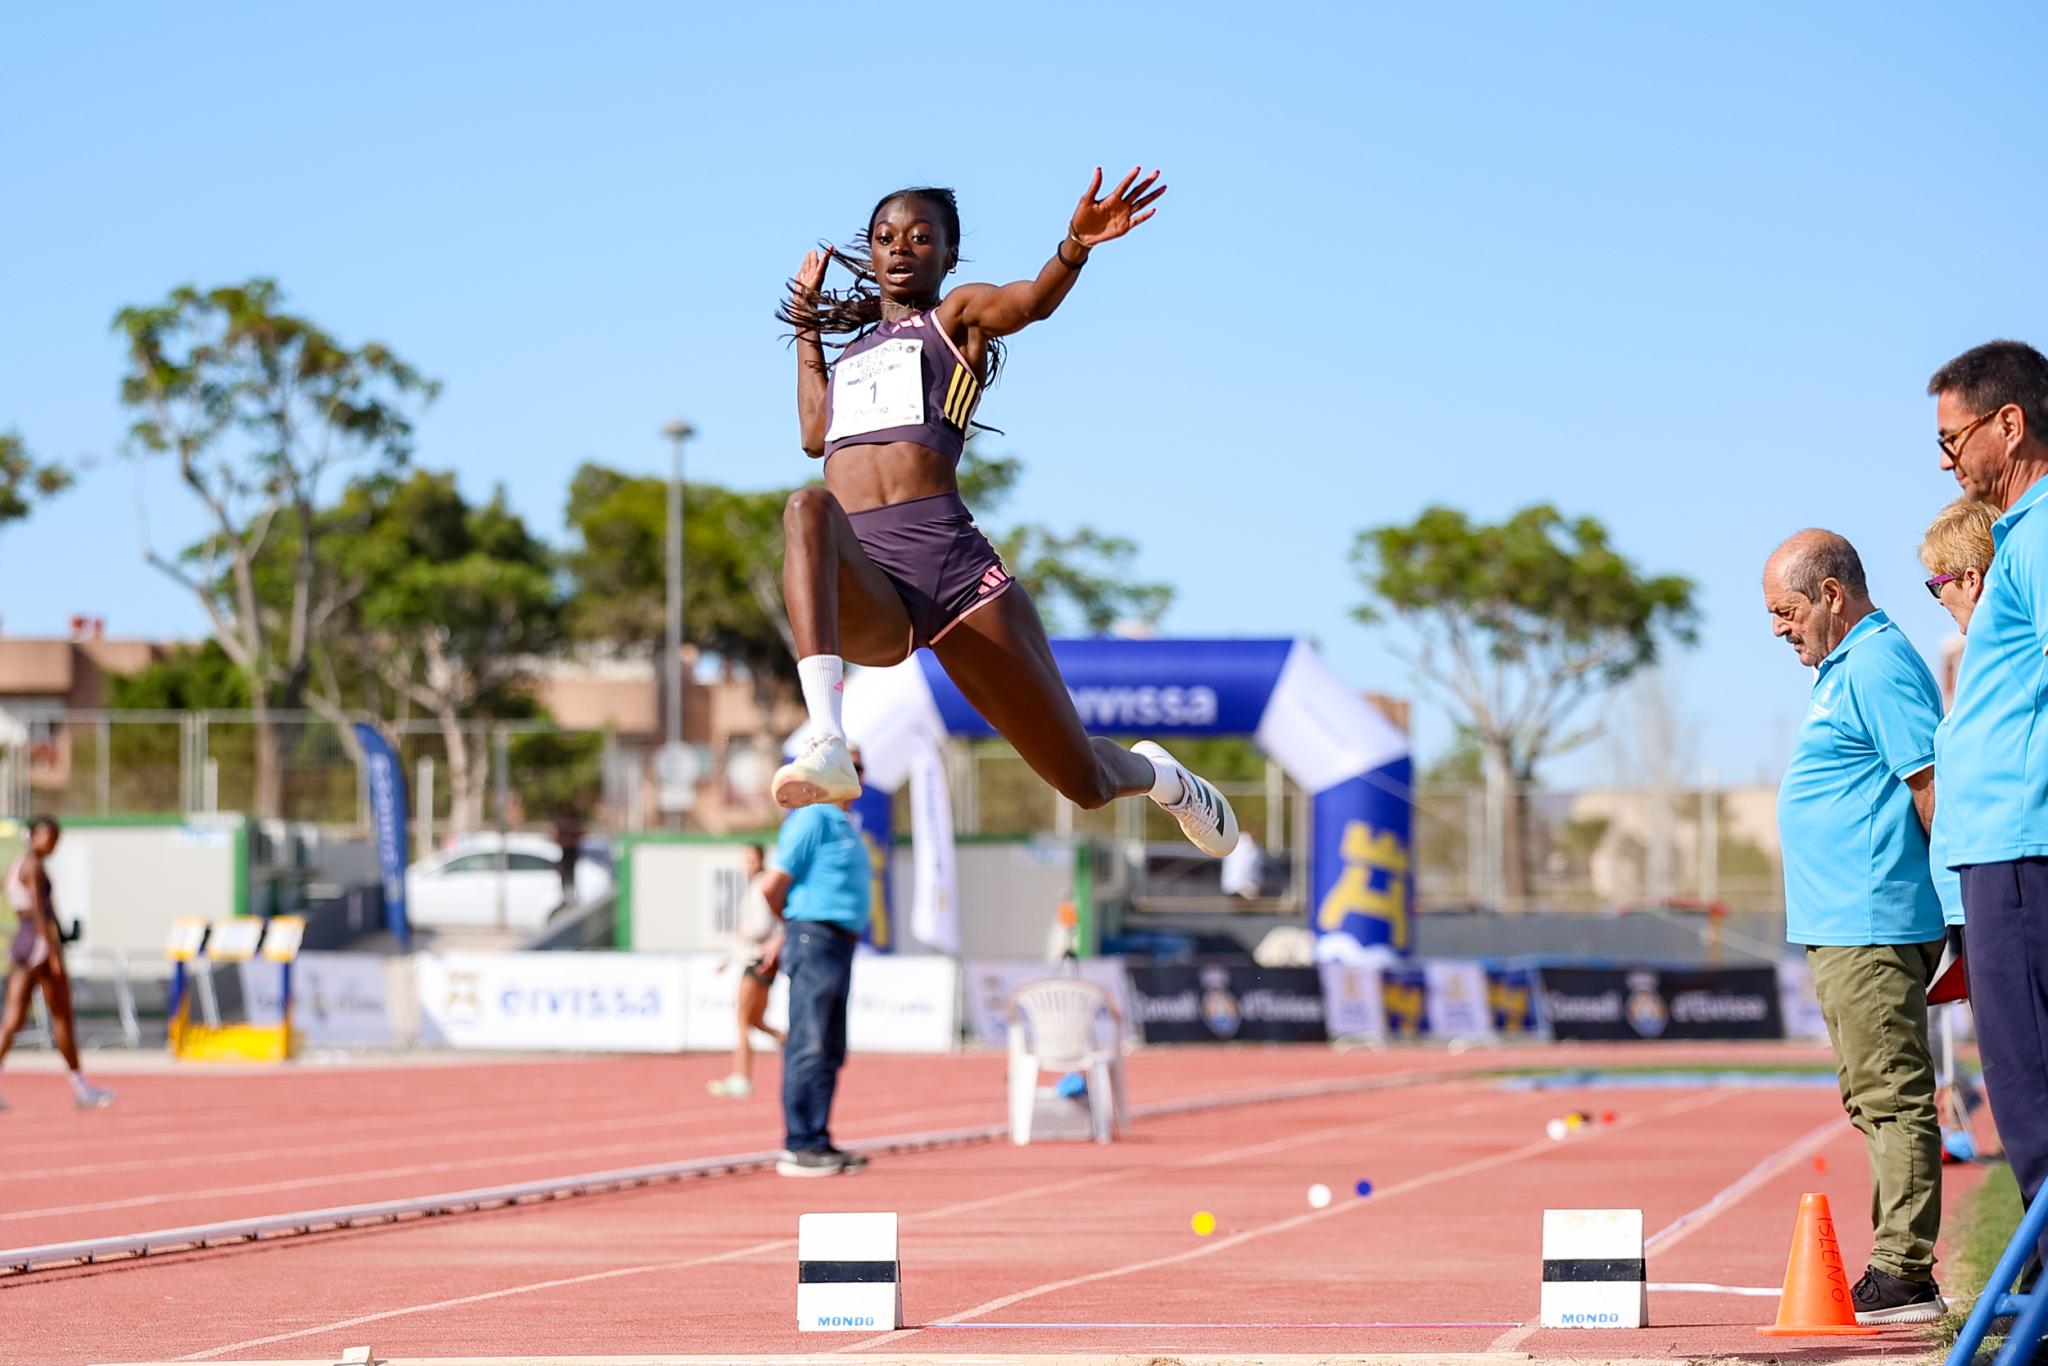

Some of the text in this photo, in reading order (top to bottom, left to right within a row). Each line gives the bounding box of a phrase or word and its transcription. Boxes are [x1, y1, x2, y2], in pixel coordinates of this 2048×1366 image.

[869, 381, 877, 404] 1
[1066, 686, 1217, 726] ivissa
[818, 1316, 875, 1327] MONDO
[1561, 1313, 1619, 1324] MONDO
